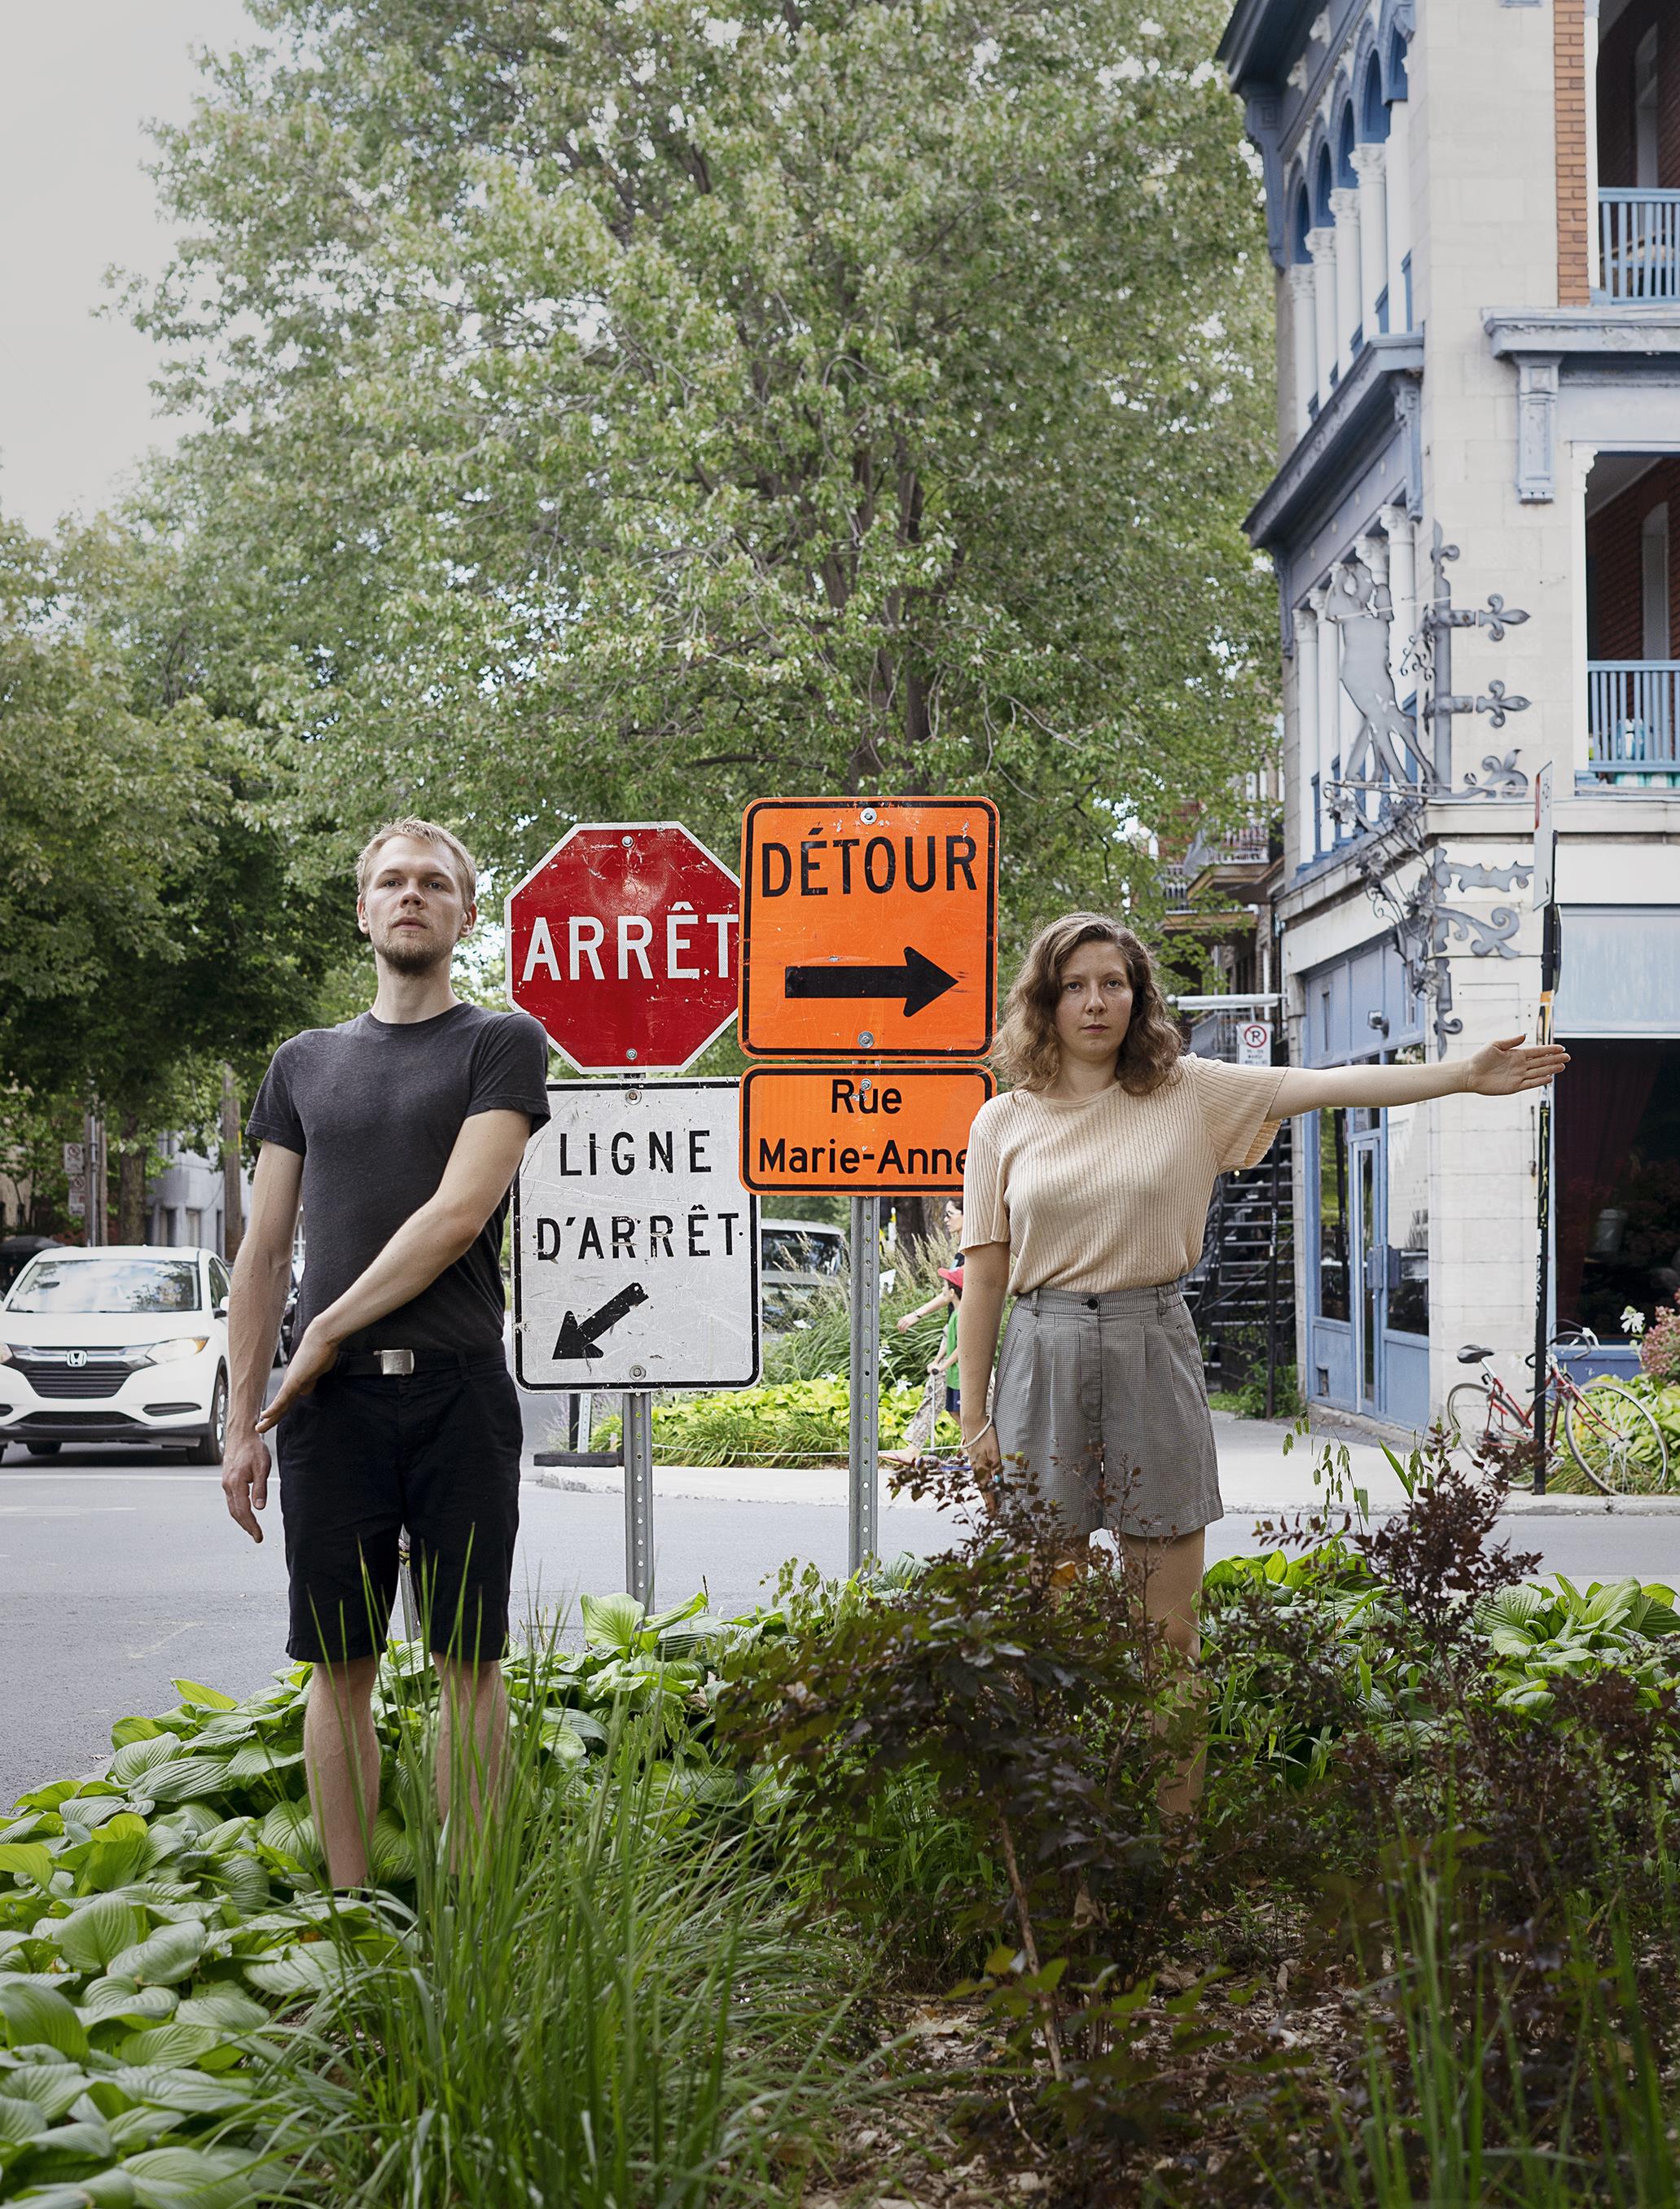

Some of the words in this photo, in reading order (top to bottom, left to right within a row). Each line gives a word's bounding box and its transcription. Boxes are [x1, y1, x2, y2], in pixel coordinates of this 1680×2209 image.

[762, 827, 977, 897] DÉTOUR
[522, 901, 739, 981] ARRÊT
[831, 1079, 902, 1114] Rue
[560, 1130, 712, 1177] LIGNE
[537, 1204, 739, 1260] D'ARRÊT
